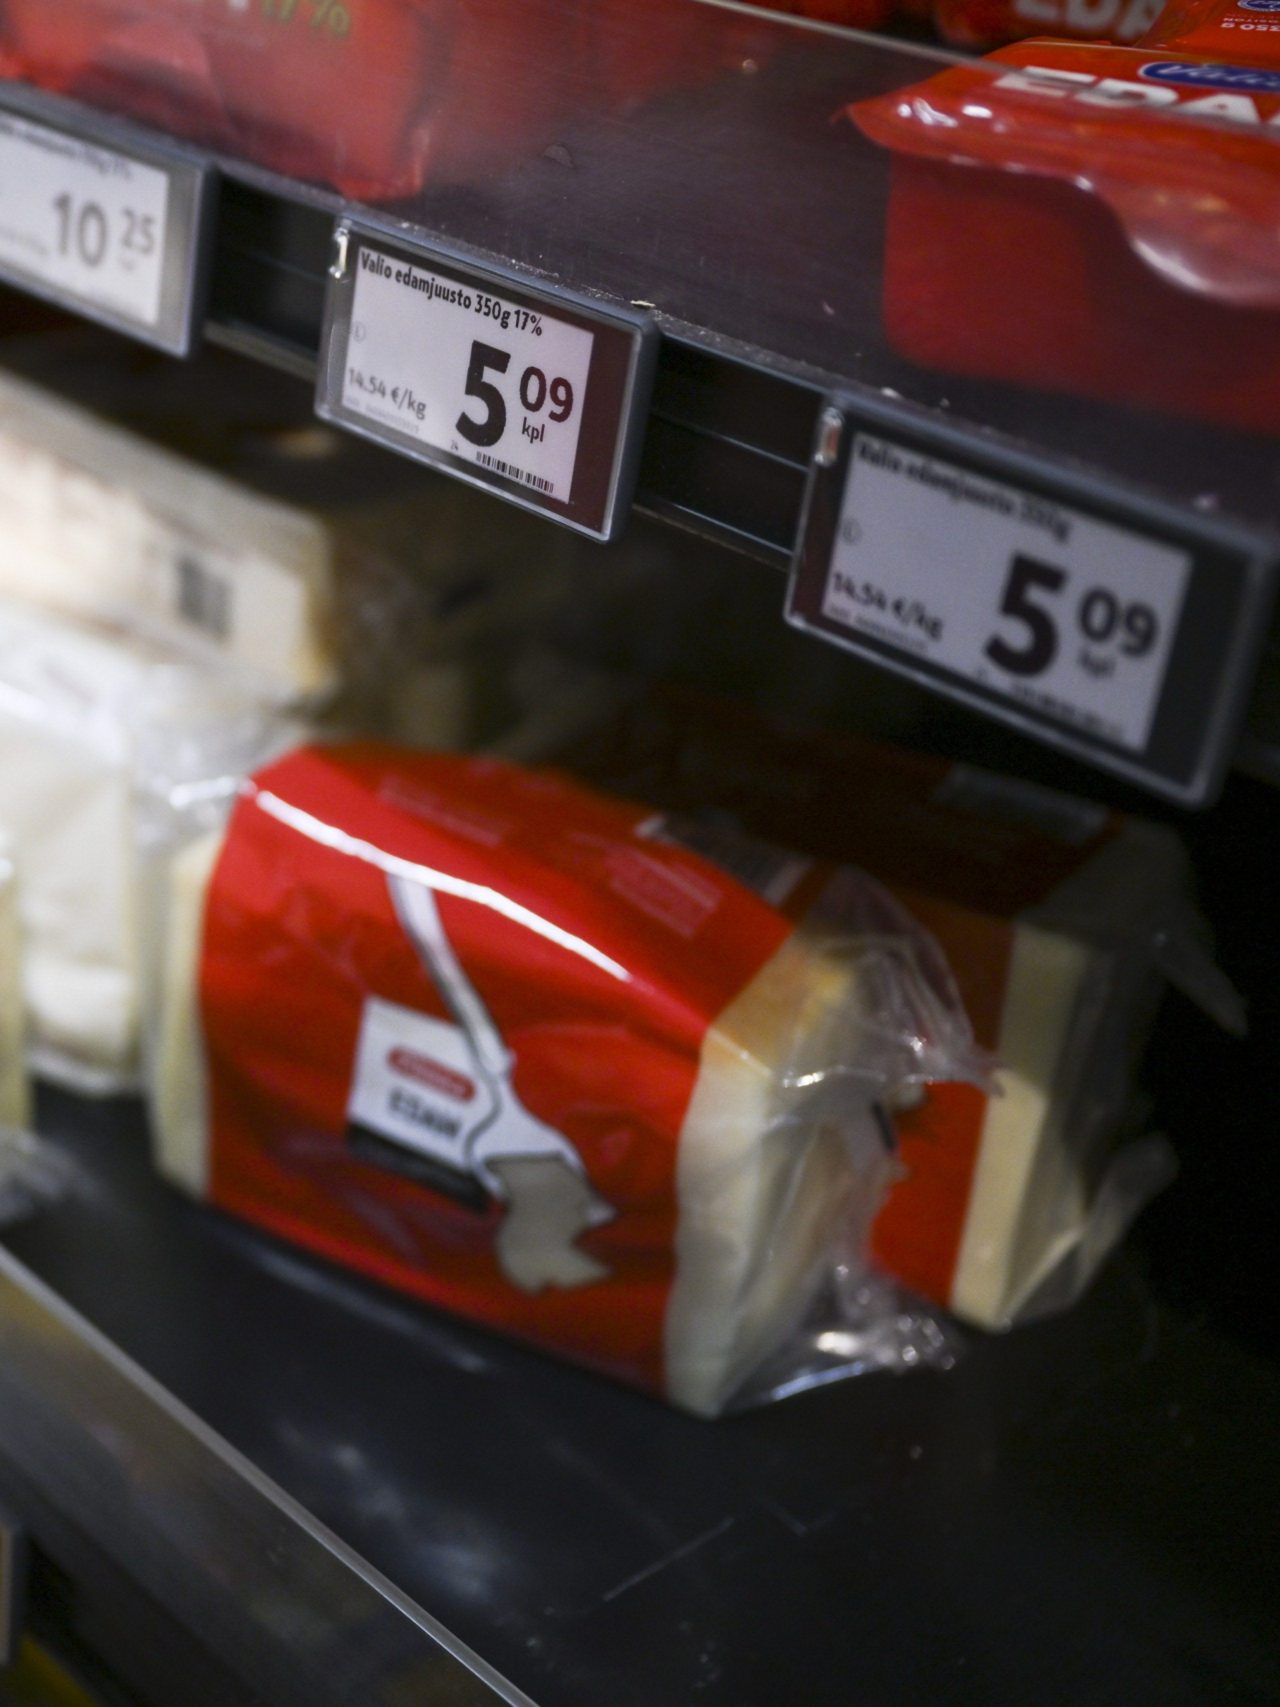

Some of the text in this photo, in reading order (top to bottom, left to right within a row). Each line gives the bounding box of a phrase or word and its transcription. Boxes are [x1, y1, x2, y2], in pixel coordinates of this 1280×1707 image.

[992, 65, 1280, 126] EDA
[53, 190, 108, 268] 10
[122, 207, 156, 255] 25
[361, 251, 542, 337] Valio edamjuusto 350g 17%
[348, 367, 387, 399] 14.54
[391, 386, 427, 421] €/kg
[455, 339, 574, 448] 5 09
[521, 416, 546, 443] kpl
[983, 551, 1161, 679] 5 09
